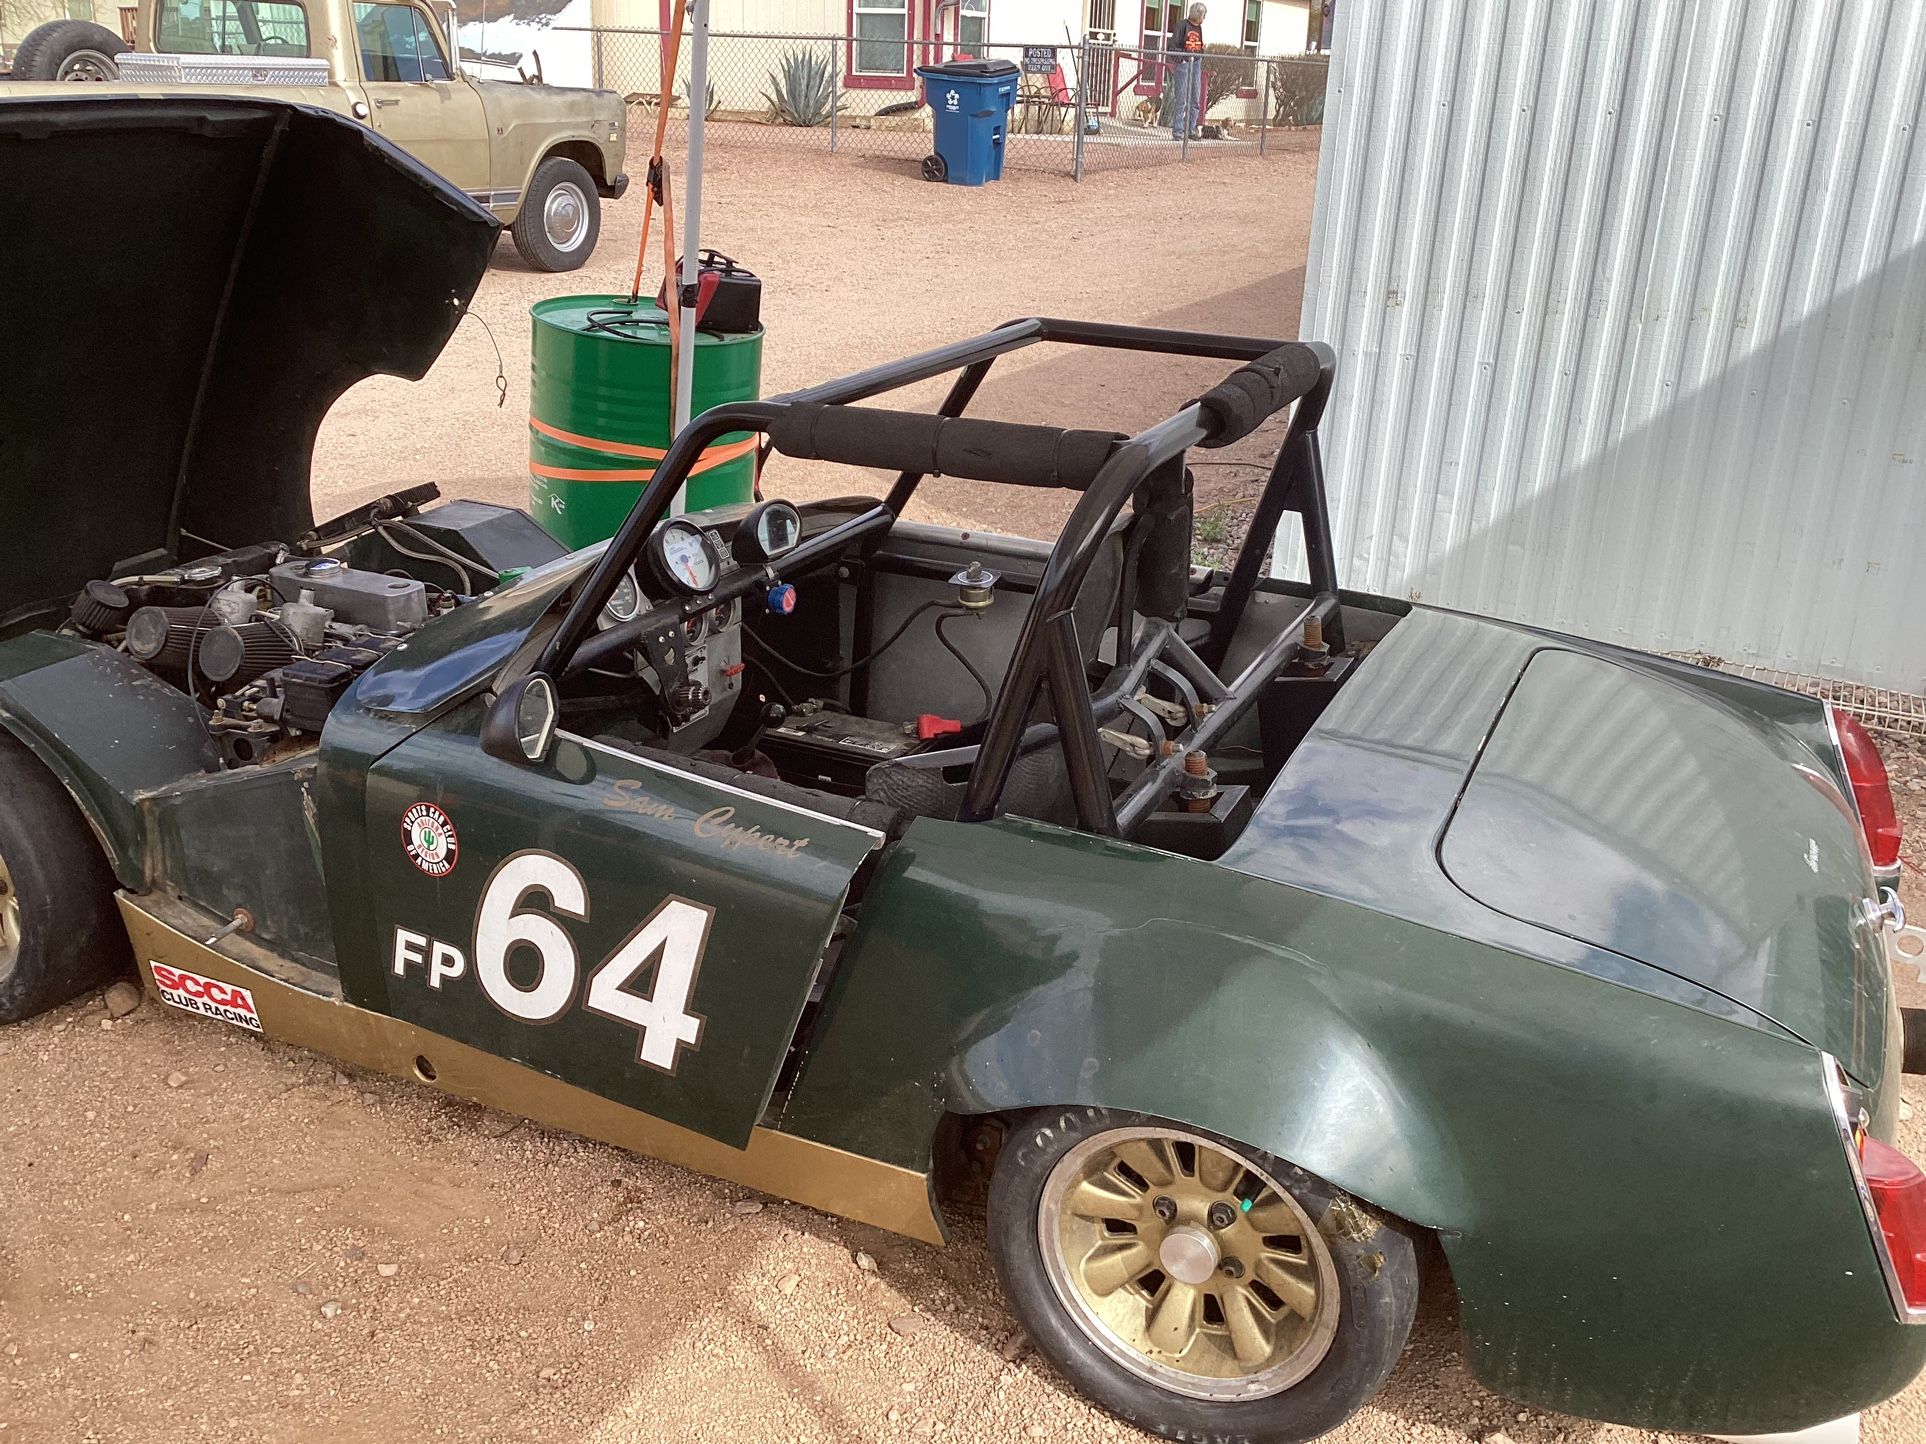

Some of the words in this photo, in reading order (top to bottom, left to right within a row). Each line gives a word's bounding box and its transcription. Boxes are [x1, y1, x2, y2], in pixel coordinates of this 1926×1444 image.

[1028, 48, 1052, 58] POSTED
[403, 804, 427, 831] SPORTS
[429, 806, 445, 825] CAR
[442, 824, 456, 850] CLUB
[406, 843, 418, 856] OF
[415, 856, 451, 874] AMERICA
[416, 843, 440, 861] REGION
[392, 926, 467, 990] FP
[473, 852, 712, 1073] 64
[153, 965, 255, 1014] SCCA
[160, 989, 200, 1011] CLUB
[202, 1002, 261, 1029] RACING
